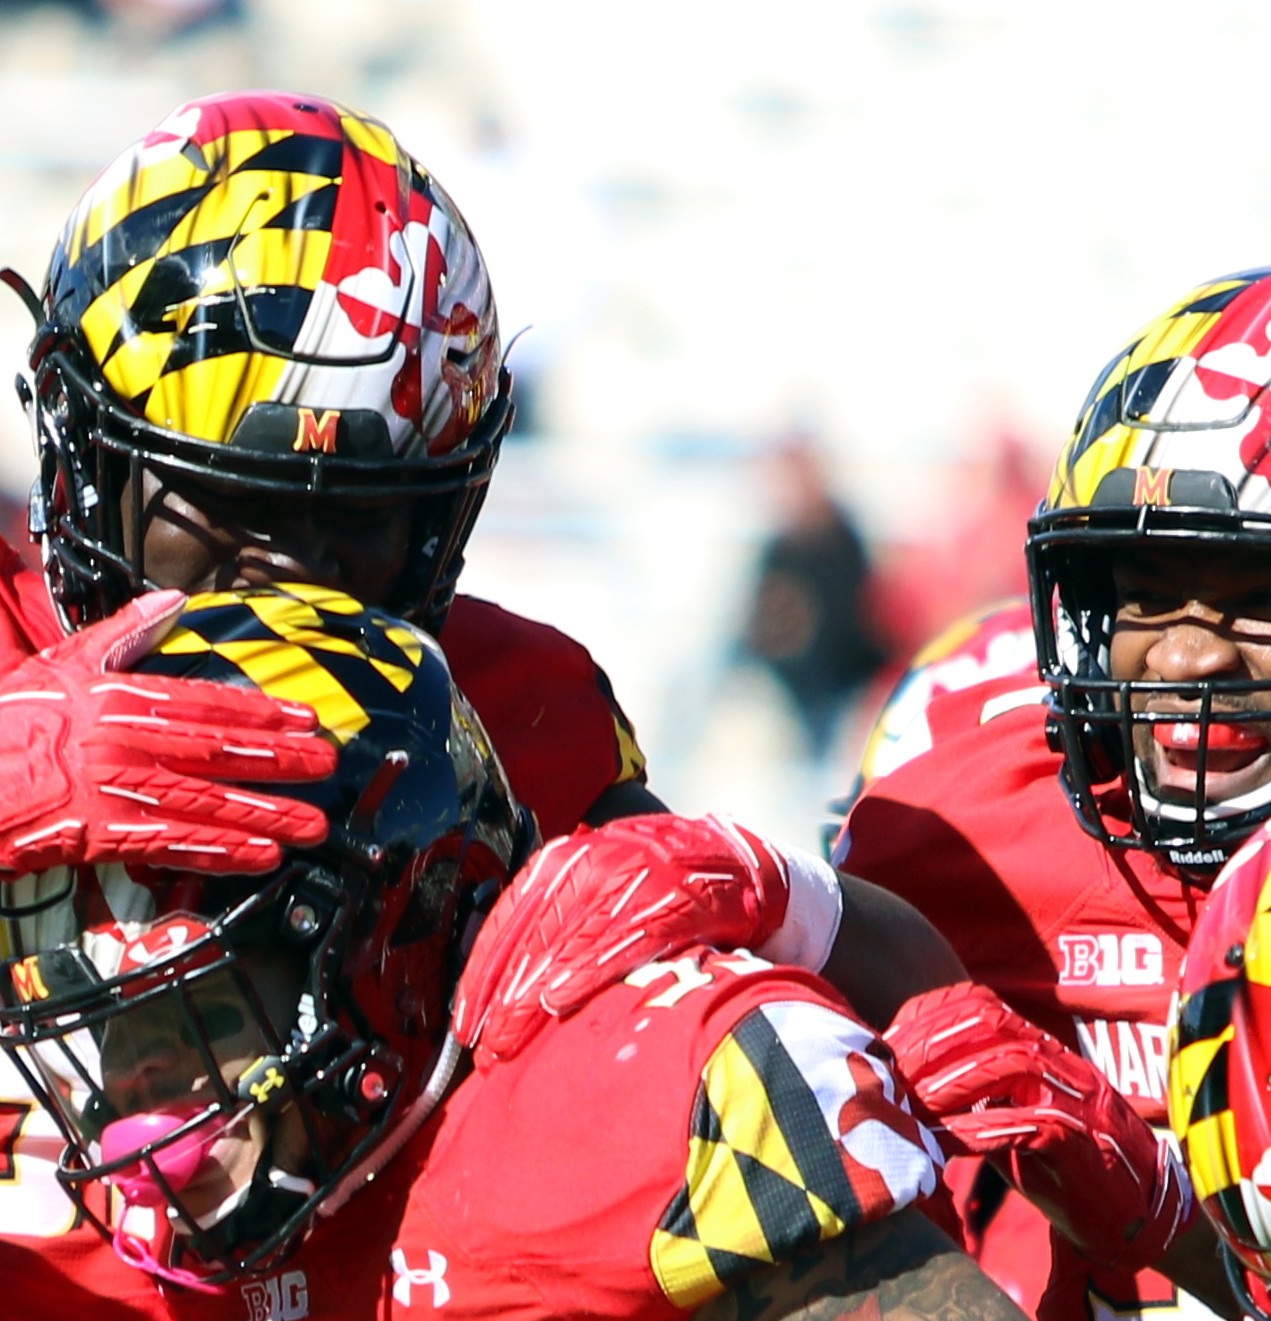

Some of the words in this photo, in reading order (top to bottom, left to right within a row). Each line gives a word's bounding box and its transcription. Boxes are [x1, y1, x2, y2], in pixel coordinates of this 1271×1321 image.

[294, 408, 341, 454] M
[1133, 466, 1173, 506] M
[1169, 850, 1225, 864] Riddell
